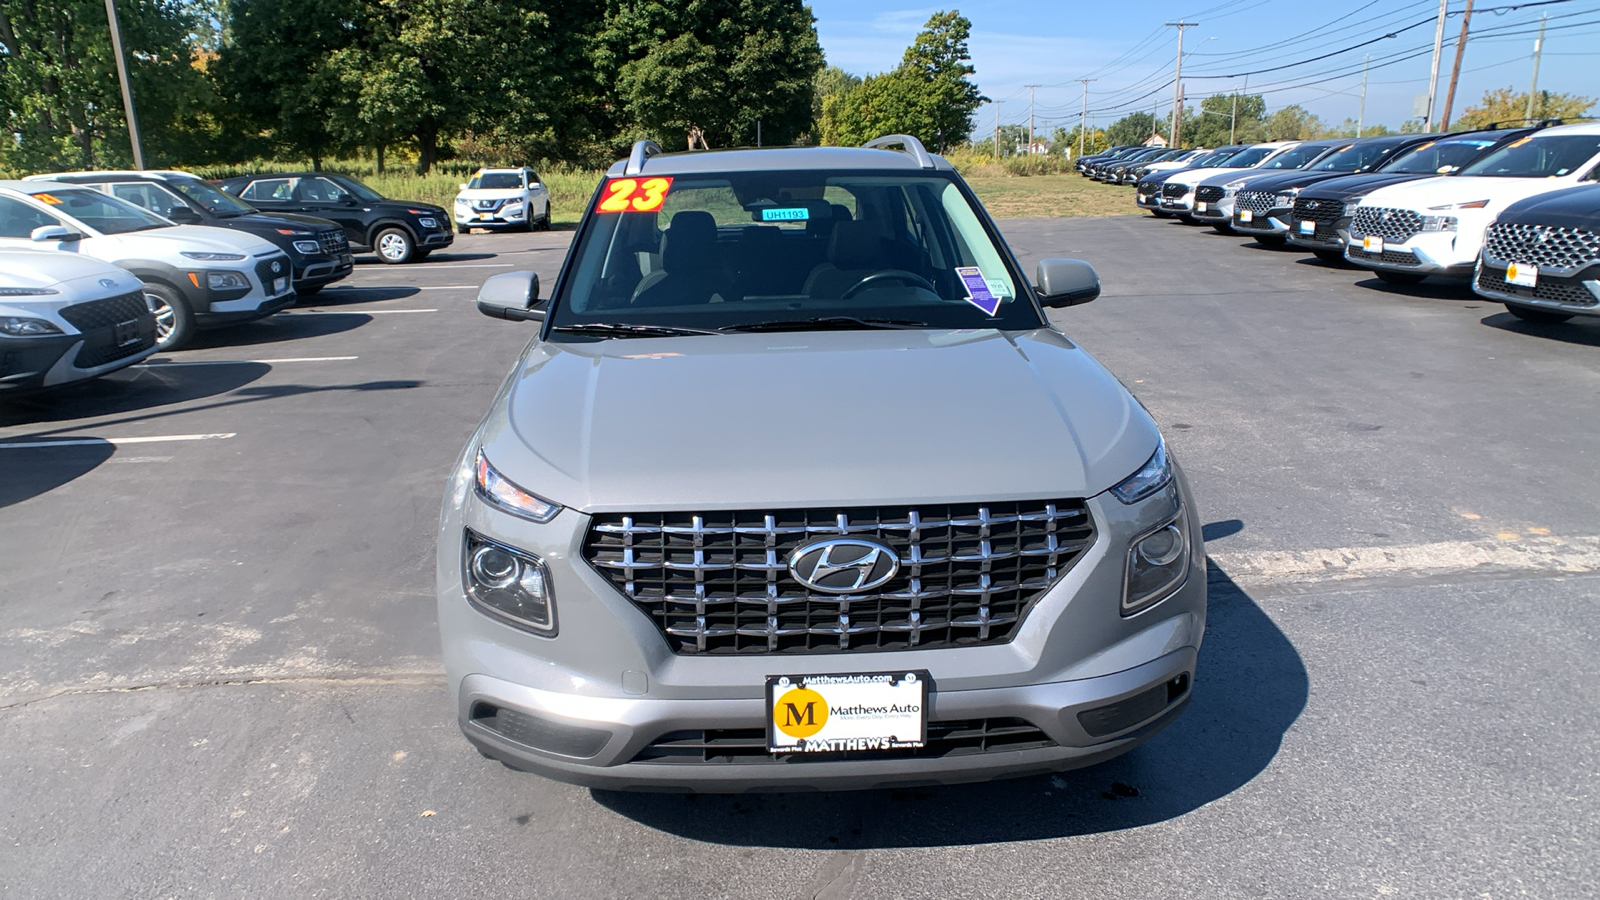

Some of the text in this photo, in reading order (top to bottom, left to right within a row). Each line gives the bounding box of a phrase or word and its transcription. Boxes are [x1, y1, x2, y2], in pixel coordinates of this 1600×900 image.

[600, 178, 669, 211] 23
[766, 210, 804, 220] UH1193
[802, 674, 893, 685] MatthewsAuto.com
[782, 701, 818, 727] M
[830, 703, 920, 716] Matthews Auto
[805, 737, 889, 752] MATTHEWS
